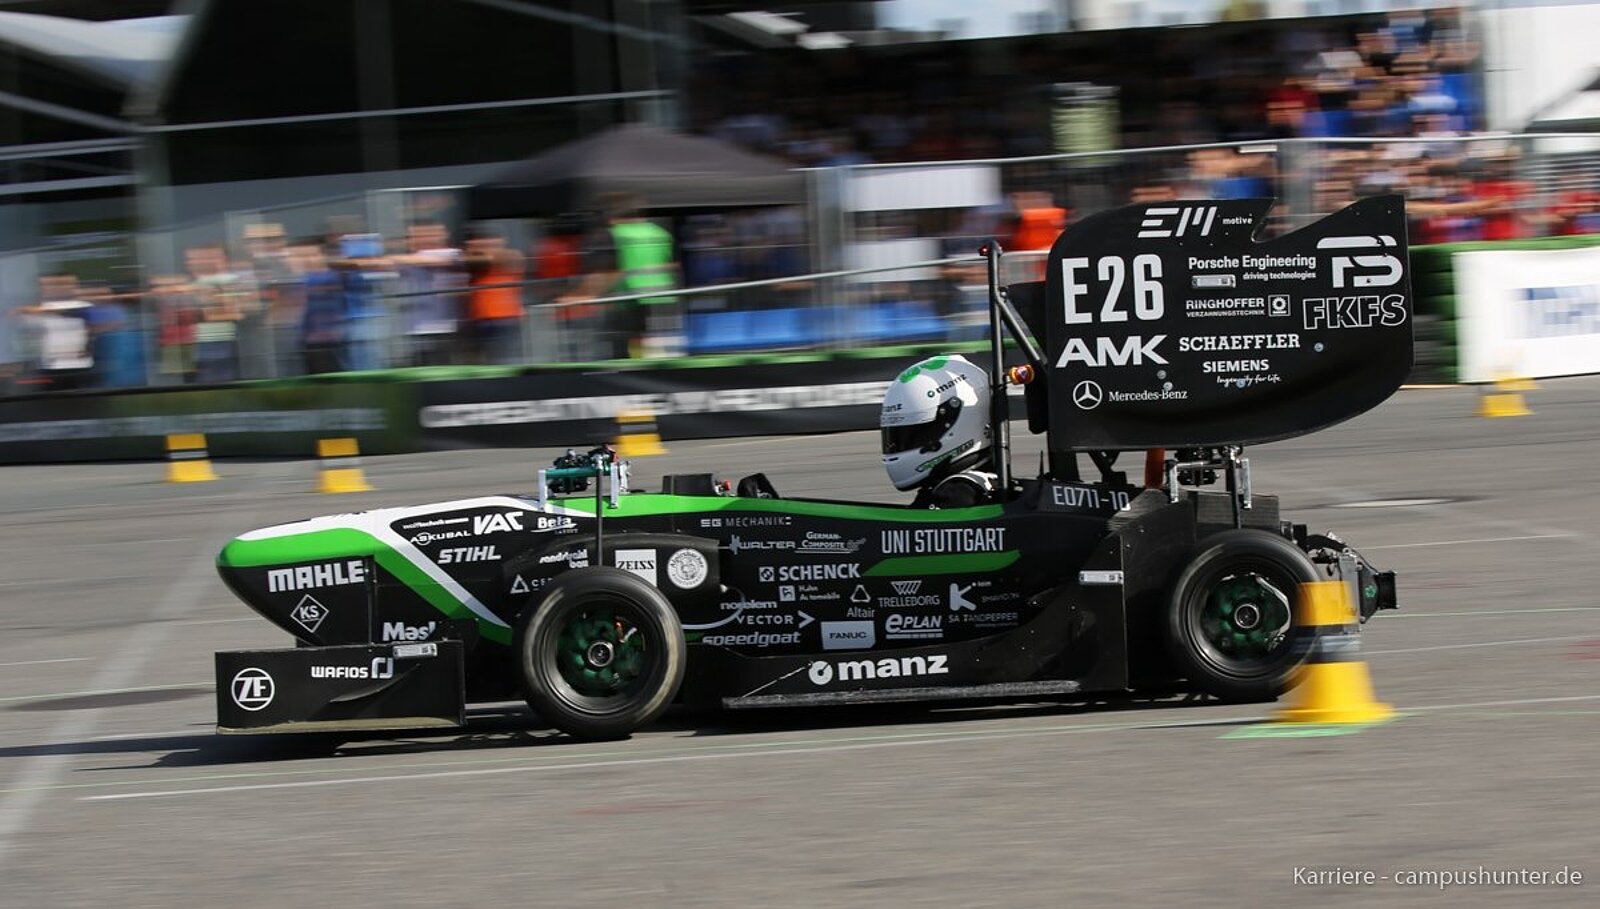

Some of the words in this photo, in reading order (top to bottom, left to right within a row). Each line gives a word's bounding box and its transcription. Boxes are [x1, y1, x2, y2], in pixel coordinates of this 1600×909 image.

[1222, 217, 1253, 225] motive
[1188, 256, 1239, 270] Porsche
[1242, 255, 1317, 269] Engineering
[1242, 272, 1269, 281] driving
[1269, 270, 1317, 281] technologies
[1061, 253, 1165, 325] E26
[1185, 298, 1265, 310] RINGHOFFER
[1186, 310, 1265, 318] VERZAHNUNGSTECHNIK
[1302, 294, 1407, 330] FKFS
[1178, 333, 1301, 352] SCHAEFFLER
[1055, 334, 1170, 368] AMK
[1202, 359, 1270, 373] SIEMENS
[1108, 389, 1188, 402] Mercedes-Benz
[473, 511, 524, 535] VAC
[725, 517, 786, 527] MECHANIK
[410, 530, 471, 545] ASKUBAL
[739, 541, 796, 549] WALTER
[881, 530, 910, 554] UNI
[914, 528, 1006, 553] STUTTGART
[437, 545, 502, 564] STIHL
[617, 561, 655, 570] ZEISS
[778, 563, 861, 581] SCHENCK
[267, 560, 366, 592] MAHLE
[878, 595, 941, 608] TRELLEBORG
[299, 605, 319, 621] KS
[846, 606, 876, 618] Altair
[736, 615, 795, 625] VECTOR
[702, 631, 802, 648] speedgoat
[829, 631, 868, 640] FANUC
[837, 654, 950, 682] manz
